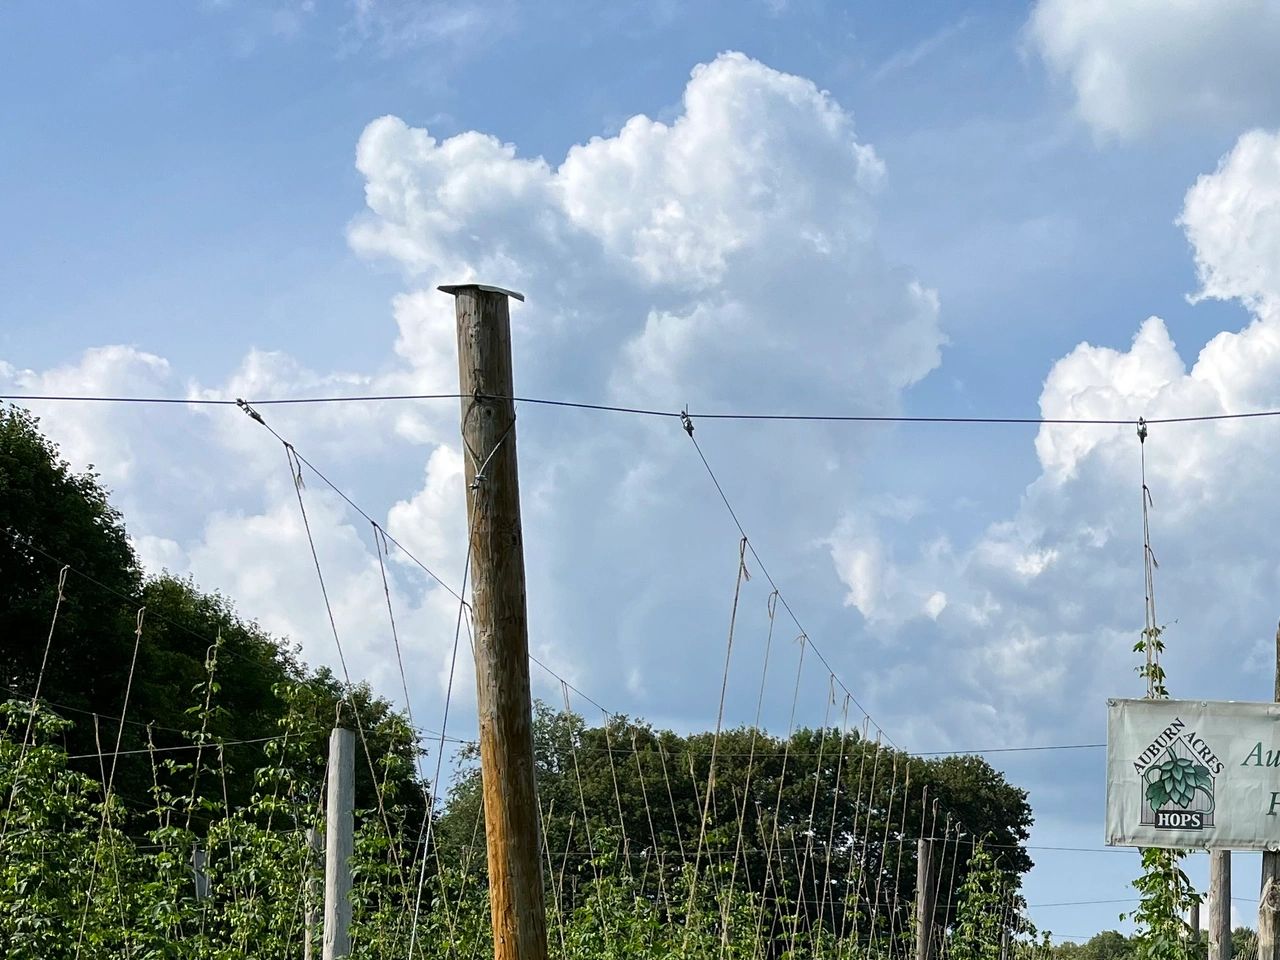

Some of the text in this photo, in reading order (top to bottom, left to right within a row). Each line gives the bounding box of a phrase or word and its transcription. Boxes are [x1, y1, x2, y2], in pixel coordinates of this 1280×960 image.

[1133, 717, 1186, 775] AUBURN
[1183, 732, 1225, 775] ACRES
[1157, 813, 1201, 827] HOPS
